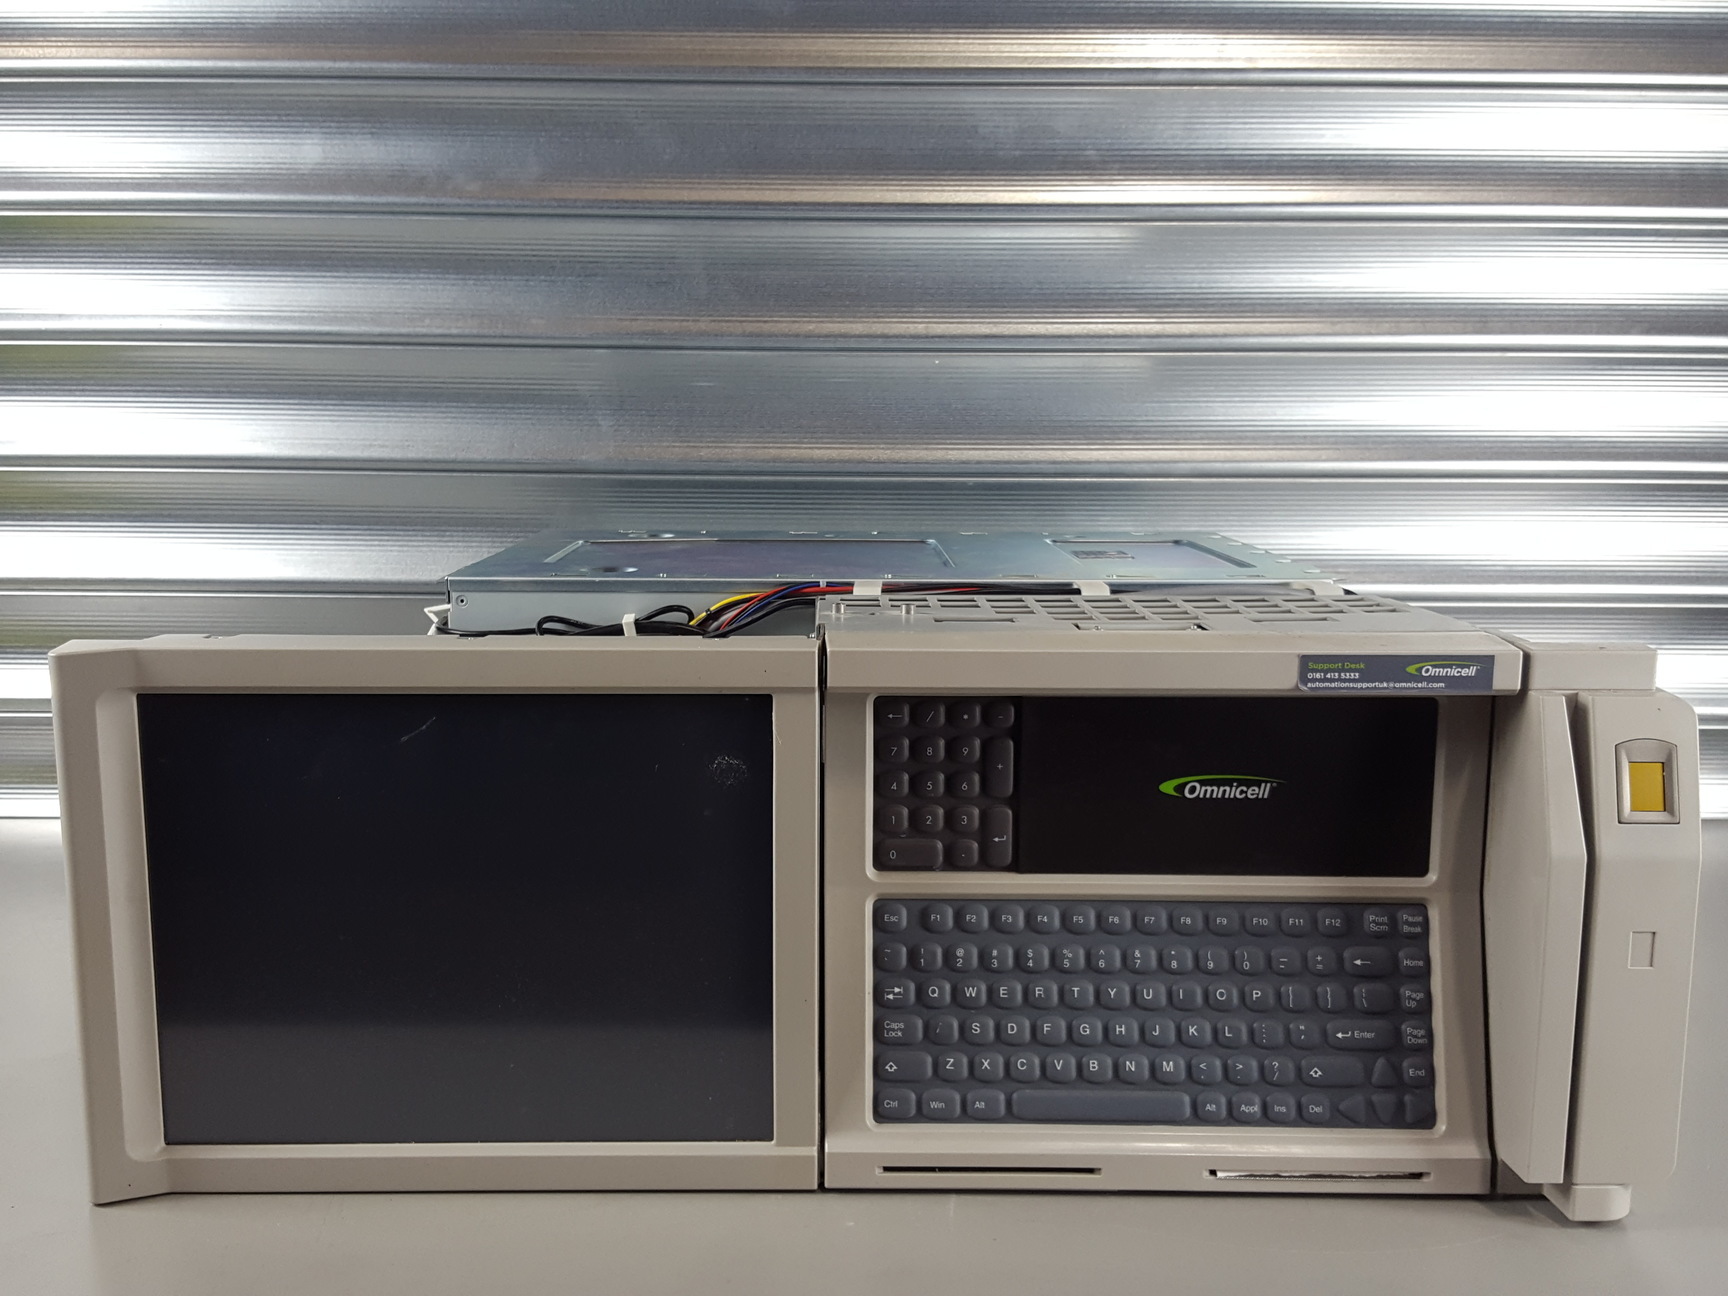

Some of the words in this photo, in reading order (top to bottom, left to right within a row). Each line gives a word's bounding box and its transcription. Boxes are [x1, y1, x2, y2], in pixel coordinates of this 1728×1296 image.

[1307, 662, 1342, 670] Support
[1421, 666, 1476, 677] Omnicell
[1307, 681, 1445, 689] automationsupportuk@omnicell.com
[890, 747, 897, 756] 7
[927, 747, 933, 756] 8
[962, 747, 969, 756] 9
[891, 782, 897, 790] 4
[926, 782, 932, 790] 5
[962, 782, 968, 790] 6
[1184, 781, 1271, 799] Omnicell
[926, 816, 932, 824] 2
[961, 816, 968, 824] 3
[1109, 916, 1119, 924] F6
[1144, 916, 1155, 924] F7
[1181, 917, 1191, 925] F8
[1216, 917, 1227, 925] F9
[1289, 918, 1303, 926] F11
[1326, 919, 1341, 927] F12
[1369, 915, 1388, 923] Print
[1403, 915, 1423, 923] Pause
[1369, 923, 1388, 932] Scrn
[1403, 925, 1422, 933] Break
[956, 959, 963, 967] 2
[991, 959, 998, 967] 3
[1027, 959, 1034, 967] 4
[1064, 959, 1070, 968] 5
[1099, 959, 1105, 968] 6
[1134, 960, 1141, 968] 7
[1171, 961, 1177, 969] 8
[1207, 961, 1214, 969] 9
[1403, 959, 1424, 967] Home
[928, 987, 939, 998] Q
[964, 987, 977, 997] W
[1000, 987, 1008, 997] E
[1035, 987, 1045, 998] R
[1072, 987, 1080, 998] T
[1108, 988, 1117, 998] Y
[1143, 988, 1153, 1000] U
[1253, 991, 1261, 1000] P
[1405, 991, 1424, 1000] Page
[1405, 999, 1417, 1008] Up
[884, 1021, 904, 1030] Caps
[972, 1023, 980, 1034] S
[1008, 1024, 1017, 1034] D
[1043, 1024, 1052, 1034] F
[1080, 1024, 1090, 1035] G
[1116, 1024, 1125, 1035] H
[884, 1029, 902, 1037] Lock
[1152, 1025, 1159, 1036] J
[1189, 1025, 1198, 1036] K
[1225, 1026, 1232, 1037] L
[1354, 1030, 1375, 1039] Enter
[1407, 1027, 1425, 1036] Page
[1407, 1036, 1428, 1044] Down
[946, 1059, 955, 1069] Z
[981, 1059, 991, 1070] X
[1017, 1059, 1027, 1070] C
[1054, 1060, 1063, 1070] V
[1090, 1060, 1099, 1071] B
[1126, 1061, 1135, 1071] N
[1163, 1062, 1173, 1072] M
[1409, 1068, 1425, 1077] End
[884, 1100, 898, 1108] Ctrl
[930, 1101, 945, 1109] Win
[974, 1101, 985, 1109] Alt
[1205, 1104, 1216, 1112] Alt
[1240, 1104, 1258, 1113] Appl
[1274, 1104, 1286, 1112] Ins
[1309, 1104, 1322, 1113] Del
